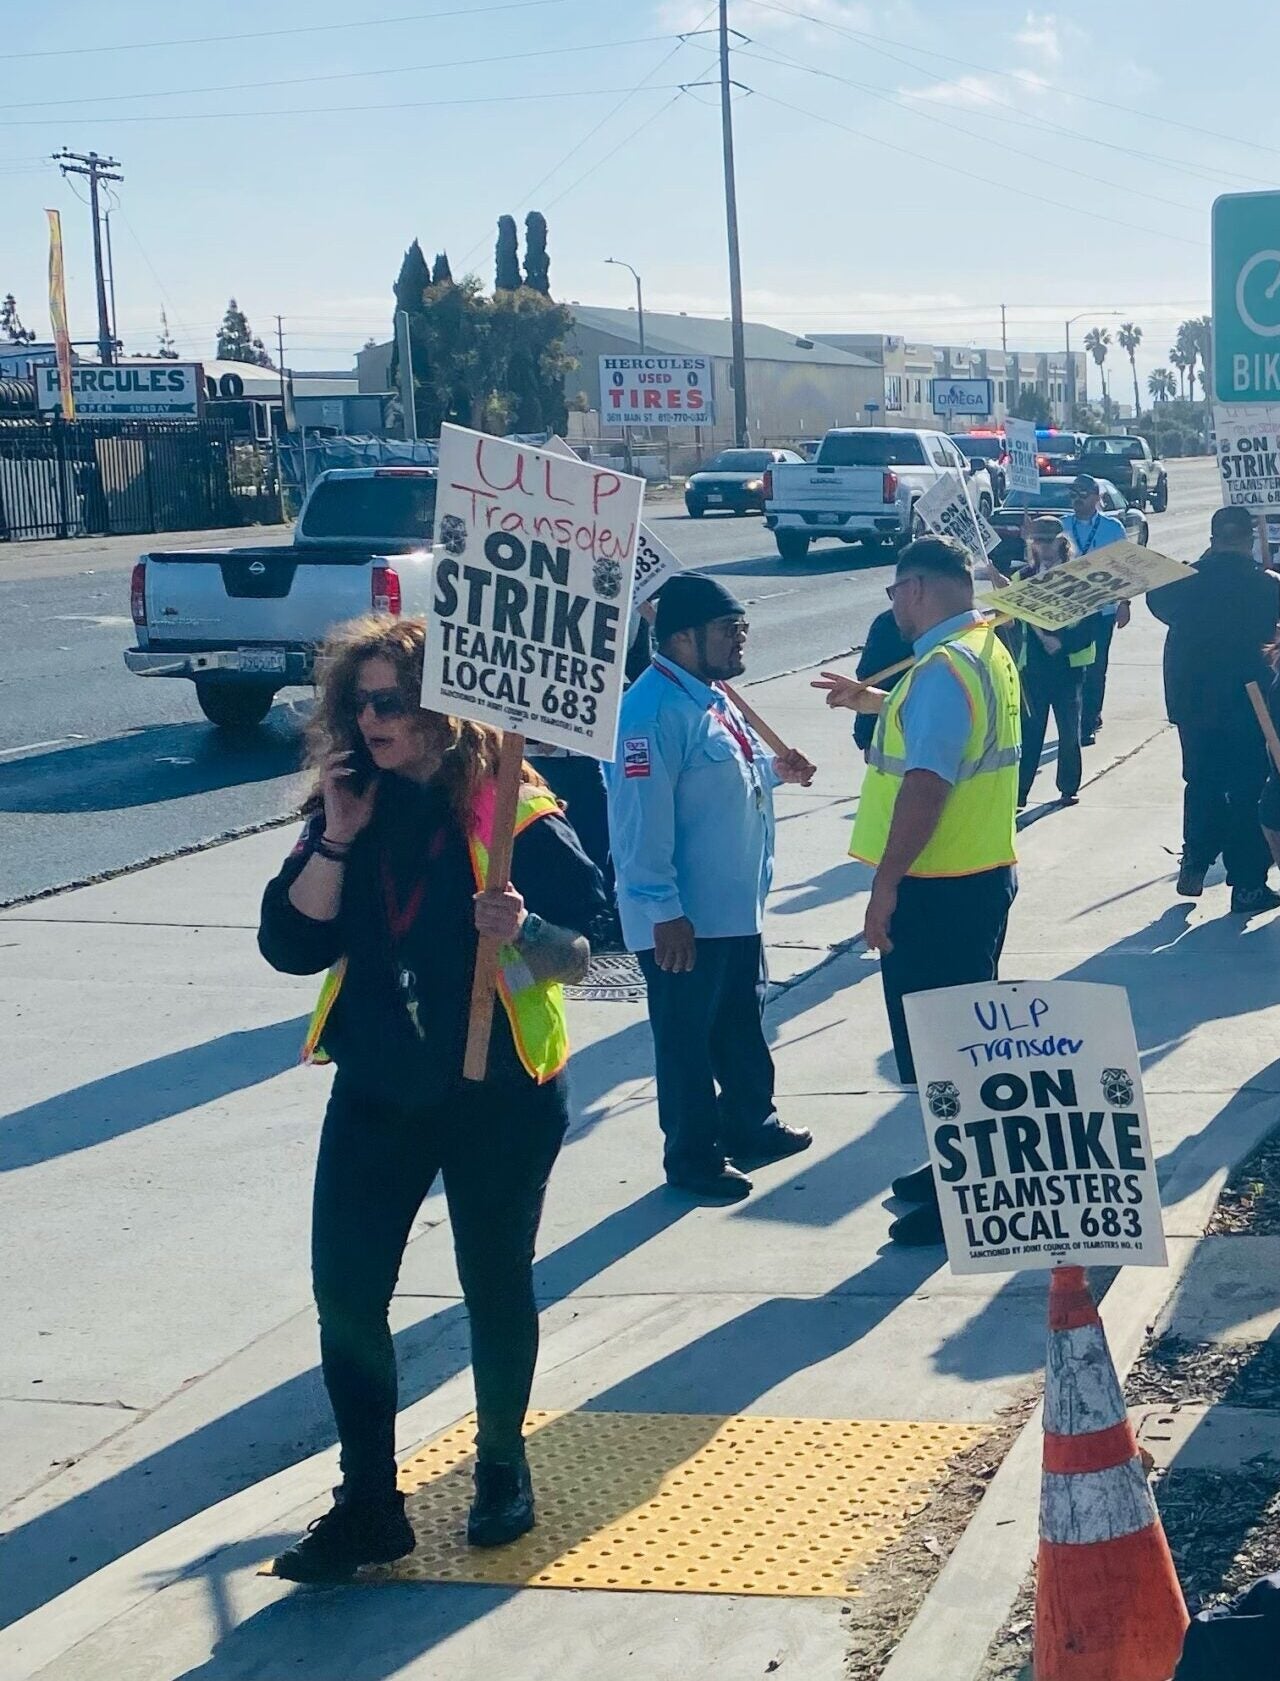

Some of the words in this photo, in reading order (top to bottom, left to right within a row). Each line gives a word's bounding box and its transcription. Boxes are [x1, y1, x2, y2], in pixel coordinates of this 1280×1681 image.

[605, 358, 705, 369] HERCULES
[46, 370, 185, 392] HERCULES
[638, 373, 672, 383] USED
[79, 404, 113, 413] OPEN
[130, 404, 170, 413] SUNDAY
[608, 389, 704, 409] TIRES
[938, 394, 984, 405] OMEGA
[1237, 436, 1268, 453] ON
[476, 439, 622, 515] ULP
[1221, 452, 1280, 479] STRIK
[1226, 477, 1280, 492] TEAMSTER
[1230, 492, 1264, 505] LOCAL
[1267, 491, 1280, 503] 68
[451, 483, 635, 562] Transdev
[940, 503, 959, 523] ON
[484, 530, 571, 587] ON
[1086, 571, 1132, 592] ON
[433, 557, 621, 665] STRIKE
[440, 619, 606, 694] TEAMSTERS
[441, 655, 531, 708] LOCAL
[541, 684, 598, 726] 683
[974, 998, 1049, 1031] ULP
[980, 1068, 1079, 1112] ON
[934, 1112, 1147, 1183] STRIKE
[952, 1173, 1143, 1215] TEAMSTERS
[965, 1209, 1070, 1248] LOCAL
[1080, 1207, 1143, 1239] 683
[969, 1248, 1011, 1259] SANCTIONED
[1012, 1246, 1021, 1255] BY
[1023, 1245, 1042, 1254] JOINT
[1043, 1243, 1072, 1252] COUNCIL
[1073, 1242, 1082, 1250] OF
[1083, 1240, 1120, 1250] TEAMSTERS
